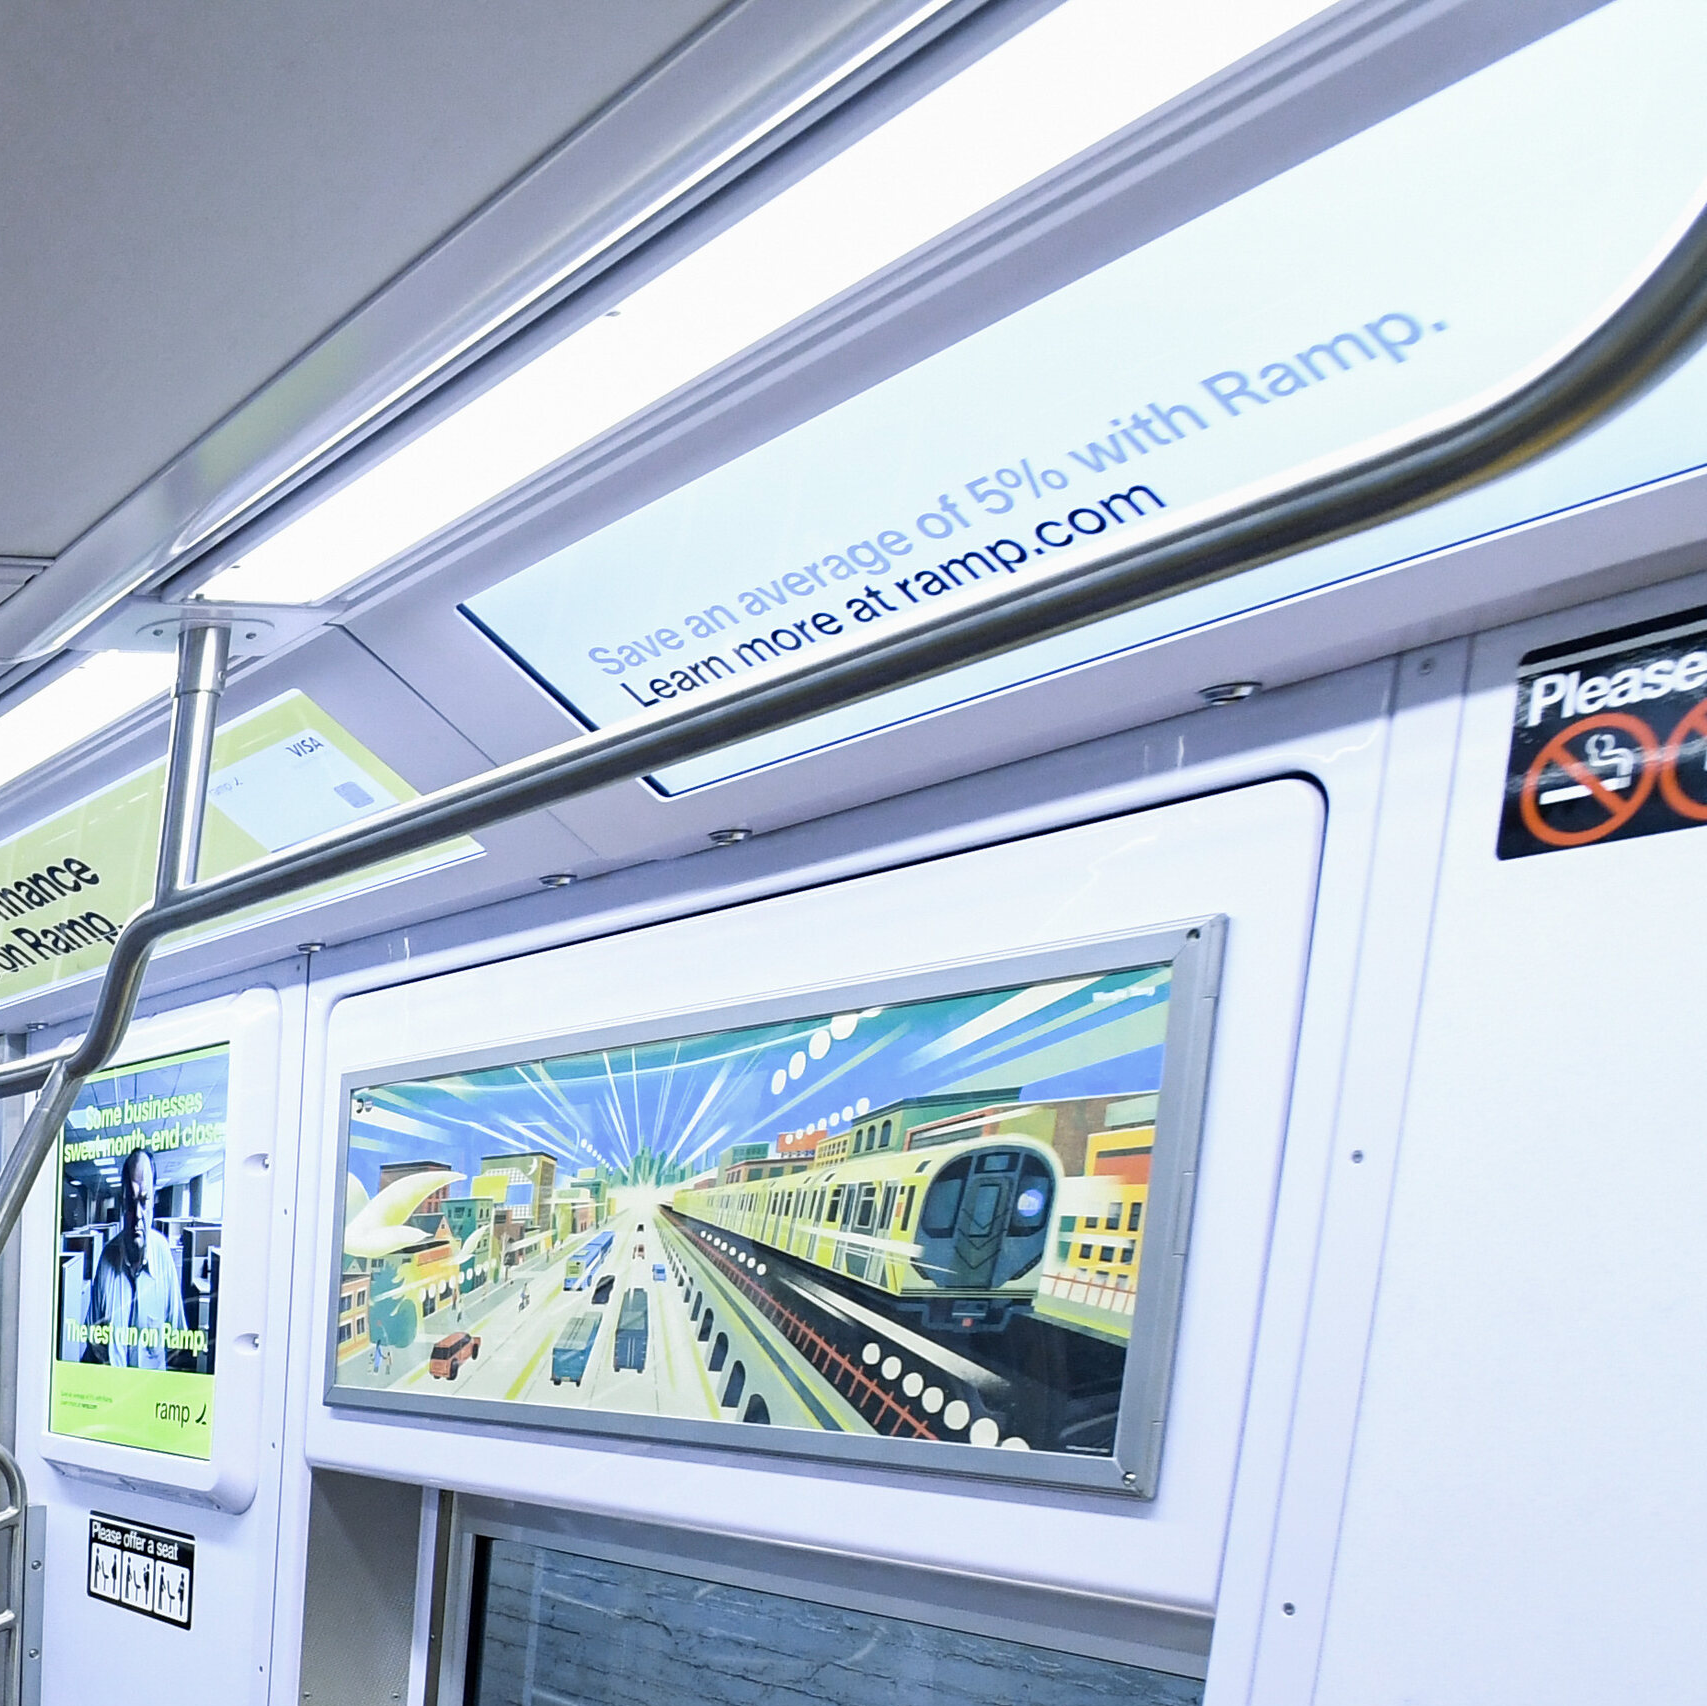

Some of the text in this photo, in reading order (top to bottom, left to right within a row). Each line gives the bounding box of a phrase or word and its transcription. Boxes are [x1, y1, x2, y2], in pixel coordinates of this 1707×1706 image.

[587, 308, 1450, 677] Save an average of 5% with Ramp.
[619, 484, 1168, 709] Learn more at ramp.com
[1525, 650, 1707, 729] Please
[284, 736, 325, 757] VISA
[11, 911, 125, 961] Ramp.
[85, 1092, 204, 1131] Some businesses
[64, 1134, 101, 1164] sweat
[100, 1121, 181, 1158] month-end
[66, 1318, 88, 1343] The
[89, 1324, 114, 1346] rest
[140, 1326, 159, 1348] on
[163, 1322, 209, 1358] Ramp.
[155, 1402, 191, 1429] ramp
[91, 1521, 180, 1561] Please offer a seat
